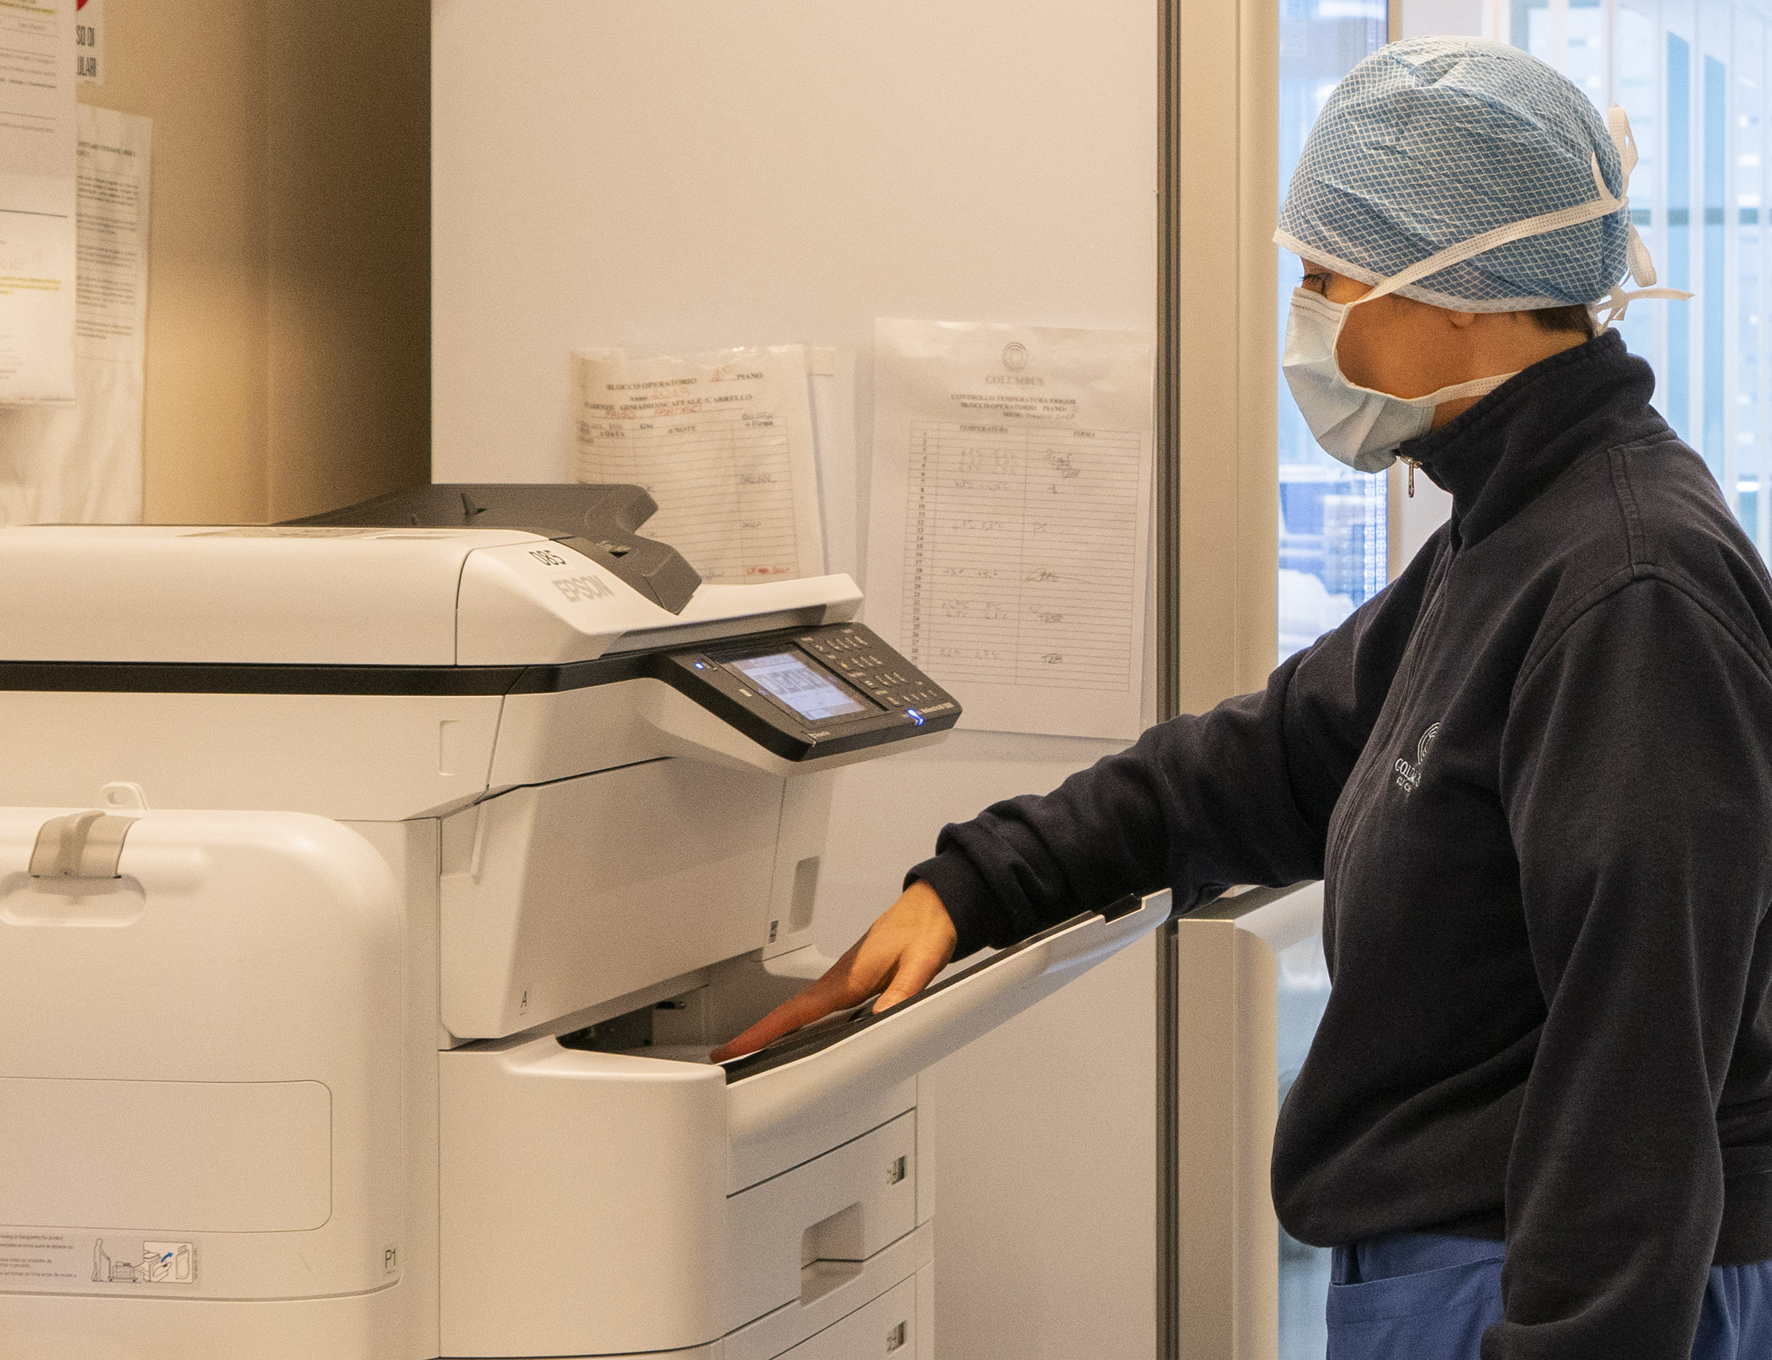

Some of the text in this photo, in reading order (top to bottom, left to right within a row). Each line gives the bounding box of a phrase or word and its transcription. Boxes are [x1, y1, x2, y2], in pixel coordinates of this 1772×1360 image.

[736, 371, 764, 381] PIANO
[985, 374, 1045, 387] COLUMBUS
[606, 377, 698, 391] BLOCCO OPERATORIO
[951, 393, 996, 402] CONTROLLO
[996, 395, 1049, 404] TEMPERATURA
[989, 403, 1037, 411] OPERATORIO
[959, 424, 1008, 433] TEMPERATURA
[528, 549, 567, 567] 085
[550, 574, 616, 603] EPSON
[520, 990, 528, 1008] A
[384, 1247, 397, 1269] P1
